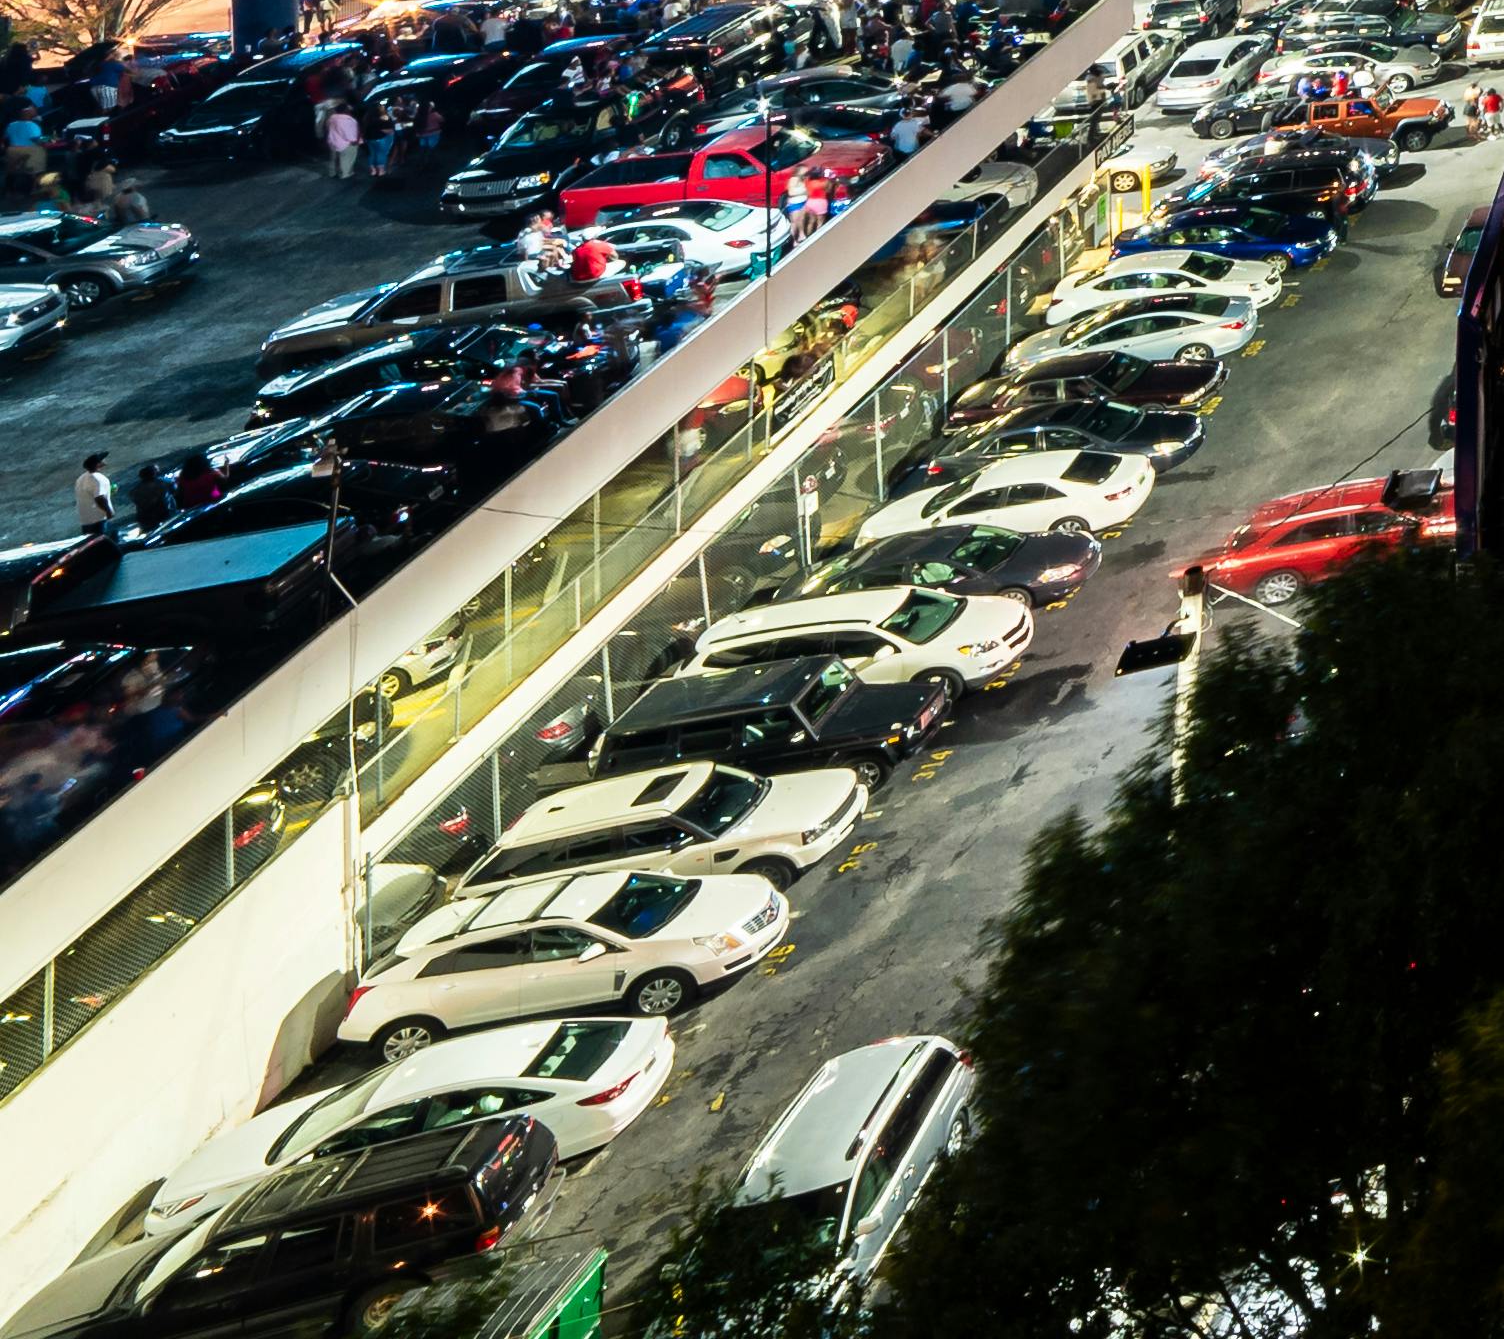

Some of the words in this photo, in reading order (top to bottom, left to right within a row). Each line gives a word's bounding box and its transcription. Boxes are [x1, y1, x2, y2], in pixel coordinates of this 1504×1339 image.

[1096, 138, 1111, 166] PAY
[1111, 119, 1133, 152] HERE
[911, 749, 954, 784] 314
